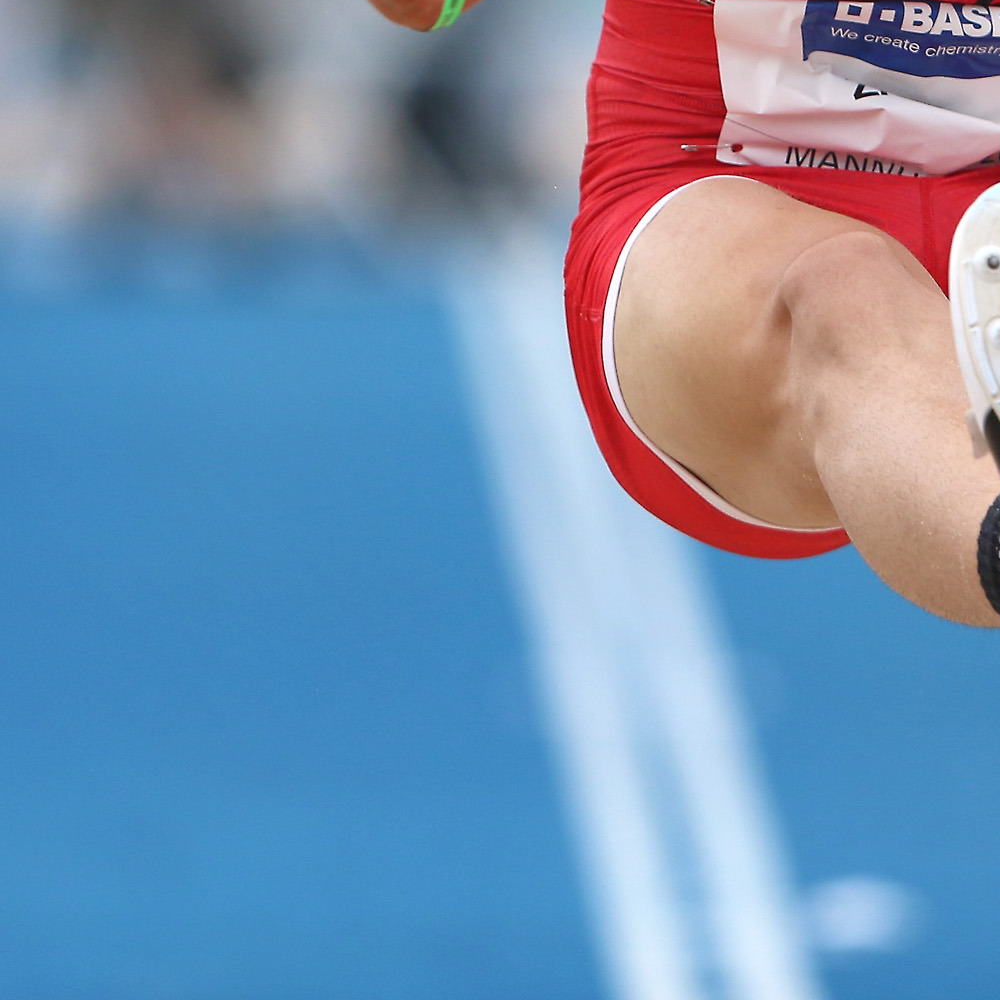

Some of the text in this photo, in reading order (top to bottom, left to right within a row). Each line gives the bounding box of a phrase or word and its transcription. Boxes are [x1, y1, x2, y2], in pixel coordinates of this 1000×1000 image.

[830, 26, 858, 40] We
[864, 34, 920, 54] create
[785, 146, 919, 177] MANN
